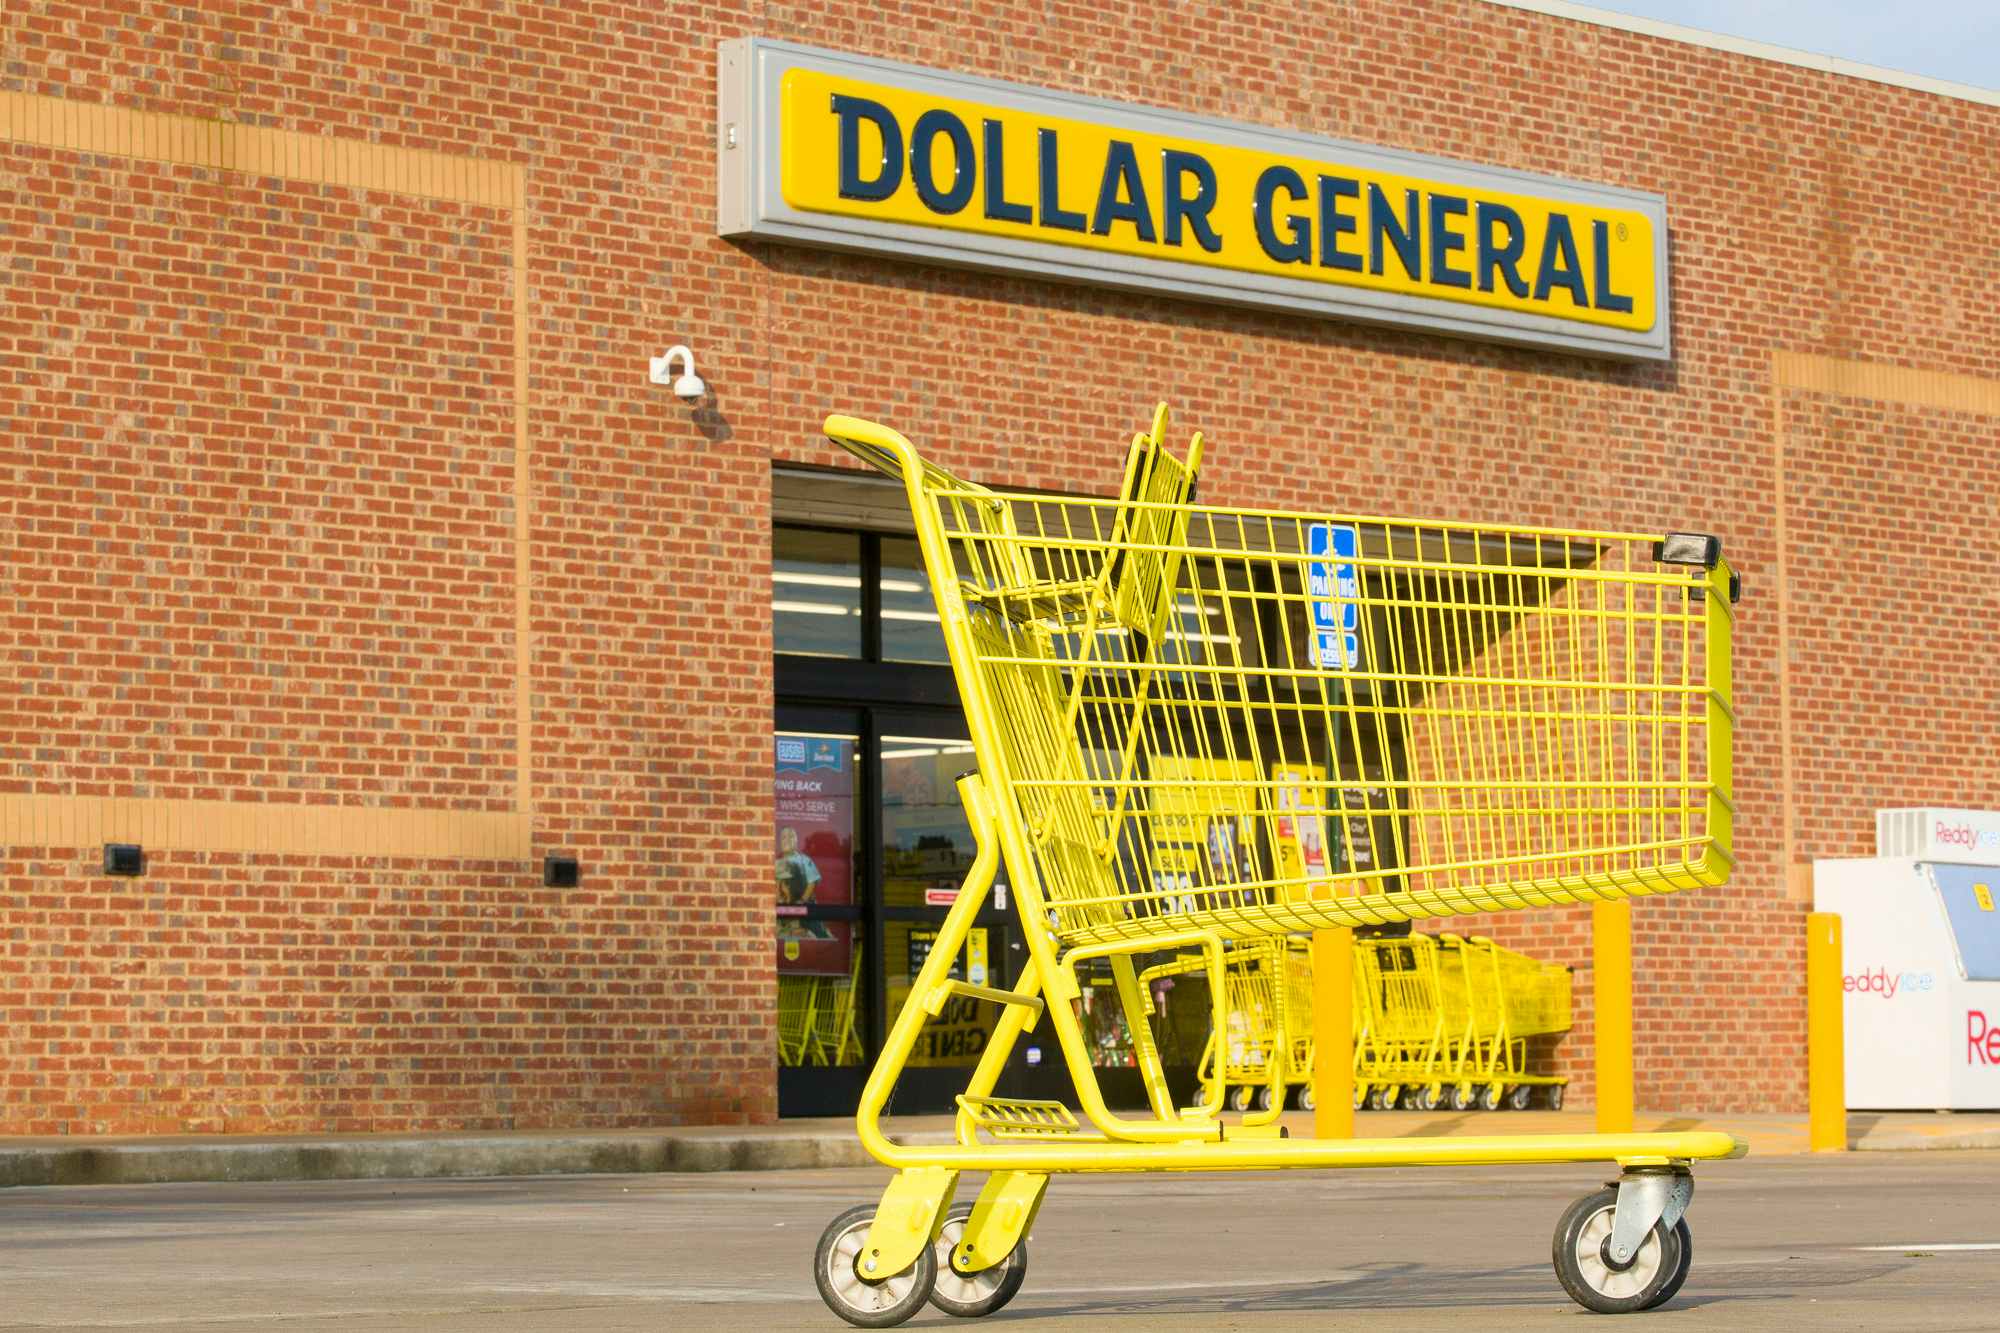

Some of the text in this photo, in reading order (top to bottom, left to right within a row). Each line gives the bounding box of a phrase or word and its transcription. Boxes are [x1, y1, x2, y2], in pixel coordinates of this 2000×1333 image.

[831, 93, 1633, 314] DOLLAR GENERAL
[796, 781, 823, 792] BACK
[781, 800, 805, 812] WHO
